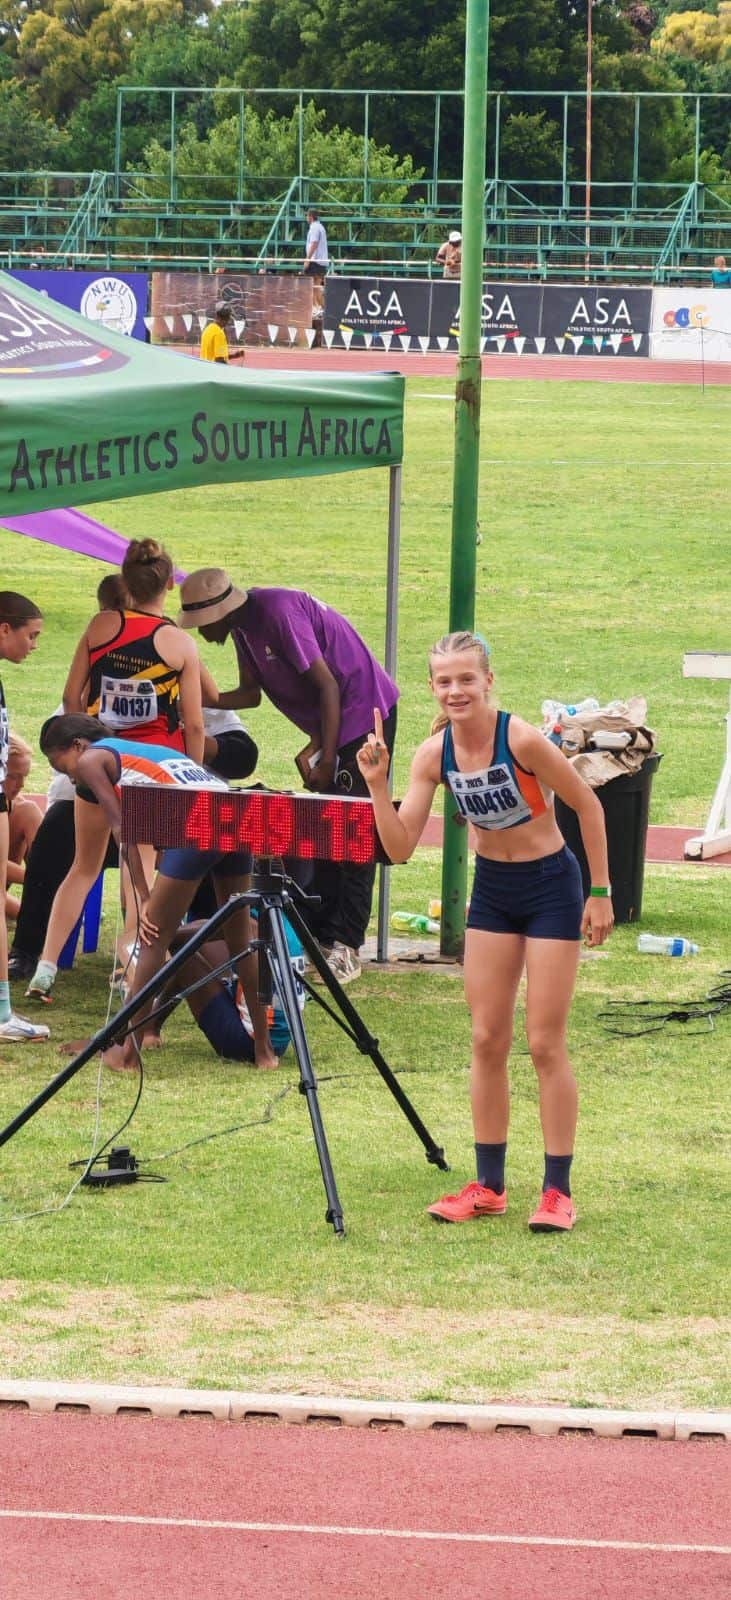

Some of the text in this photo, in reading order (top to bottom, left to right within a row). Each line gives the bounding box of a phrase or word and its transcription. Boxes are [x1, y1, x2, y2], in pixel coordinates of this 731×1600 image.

[91, 281, 128, 296] NWU
[344, 289, 404, 317] ASA
[455, 294, 516, 321] SA
[570, 297, 632, 325] ASA
[8, 407, 392, 492] ATHLETICS SOUTH AFRICA
[112, 697, 151, 717] 40137
[465, 788, 518, 816] 40418
[185, 791, 375, 864] 4:49.13
